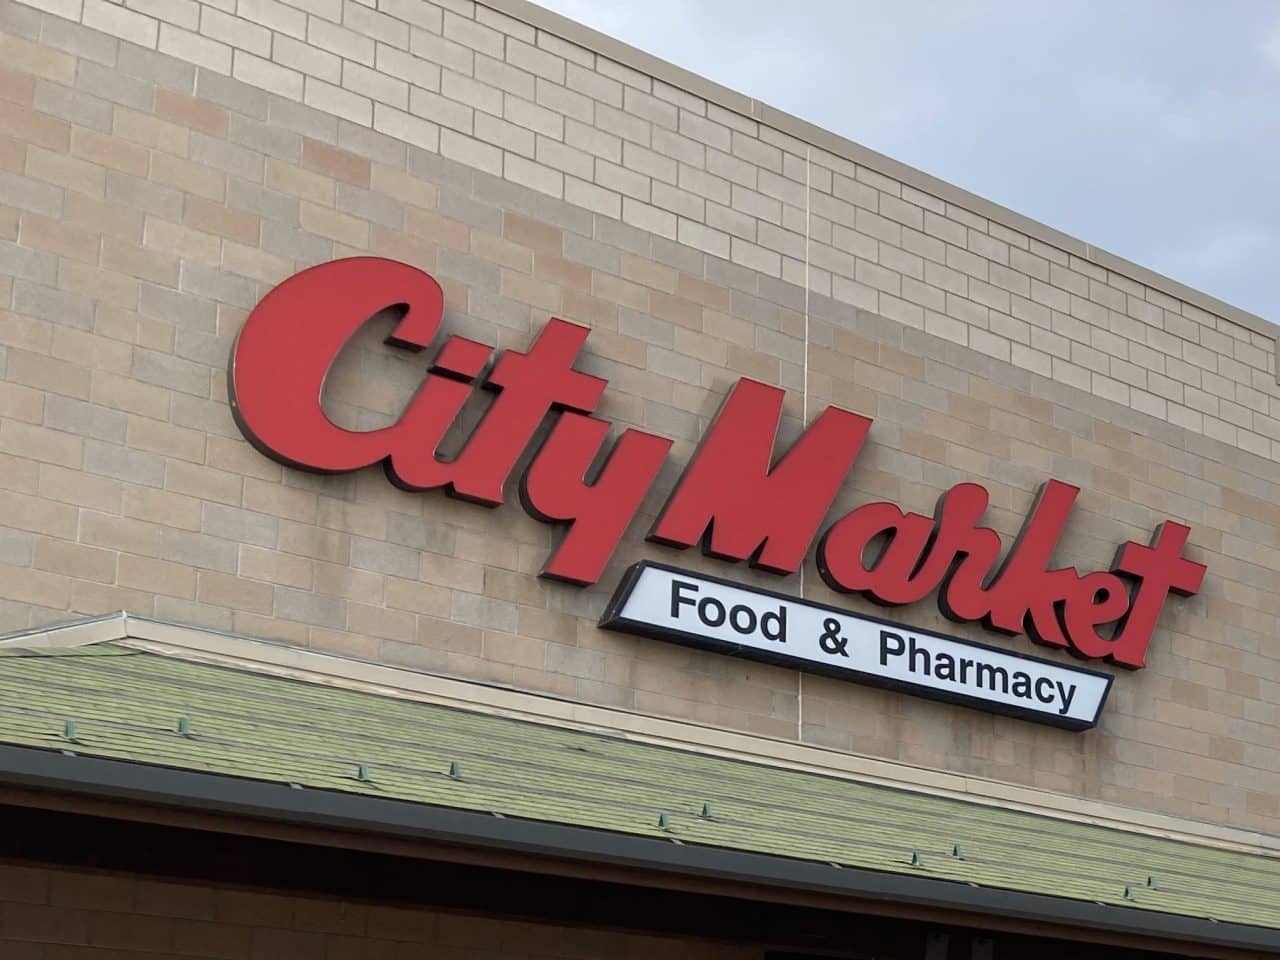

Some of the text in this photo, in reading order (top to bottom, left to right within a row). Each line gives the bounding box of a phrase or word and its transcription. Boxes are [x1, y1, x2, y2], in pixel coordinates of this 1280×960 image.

[227, 255, 1207, 670] City Market
[668, 577, 1078, 714] Food & Pharmacy
